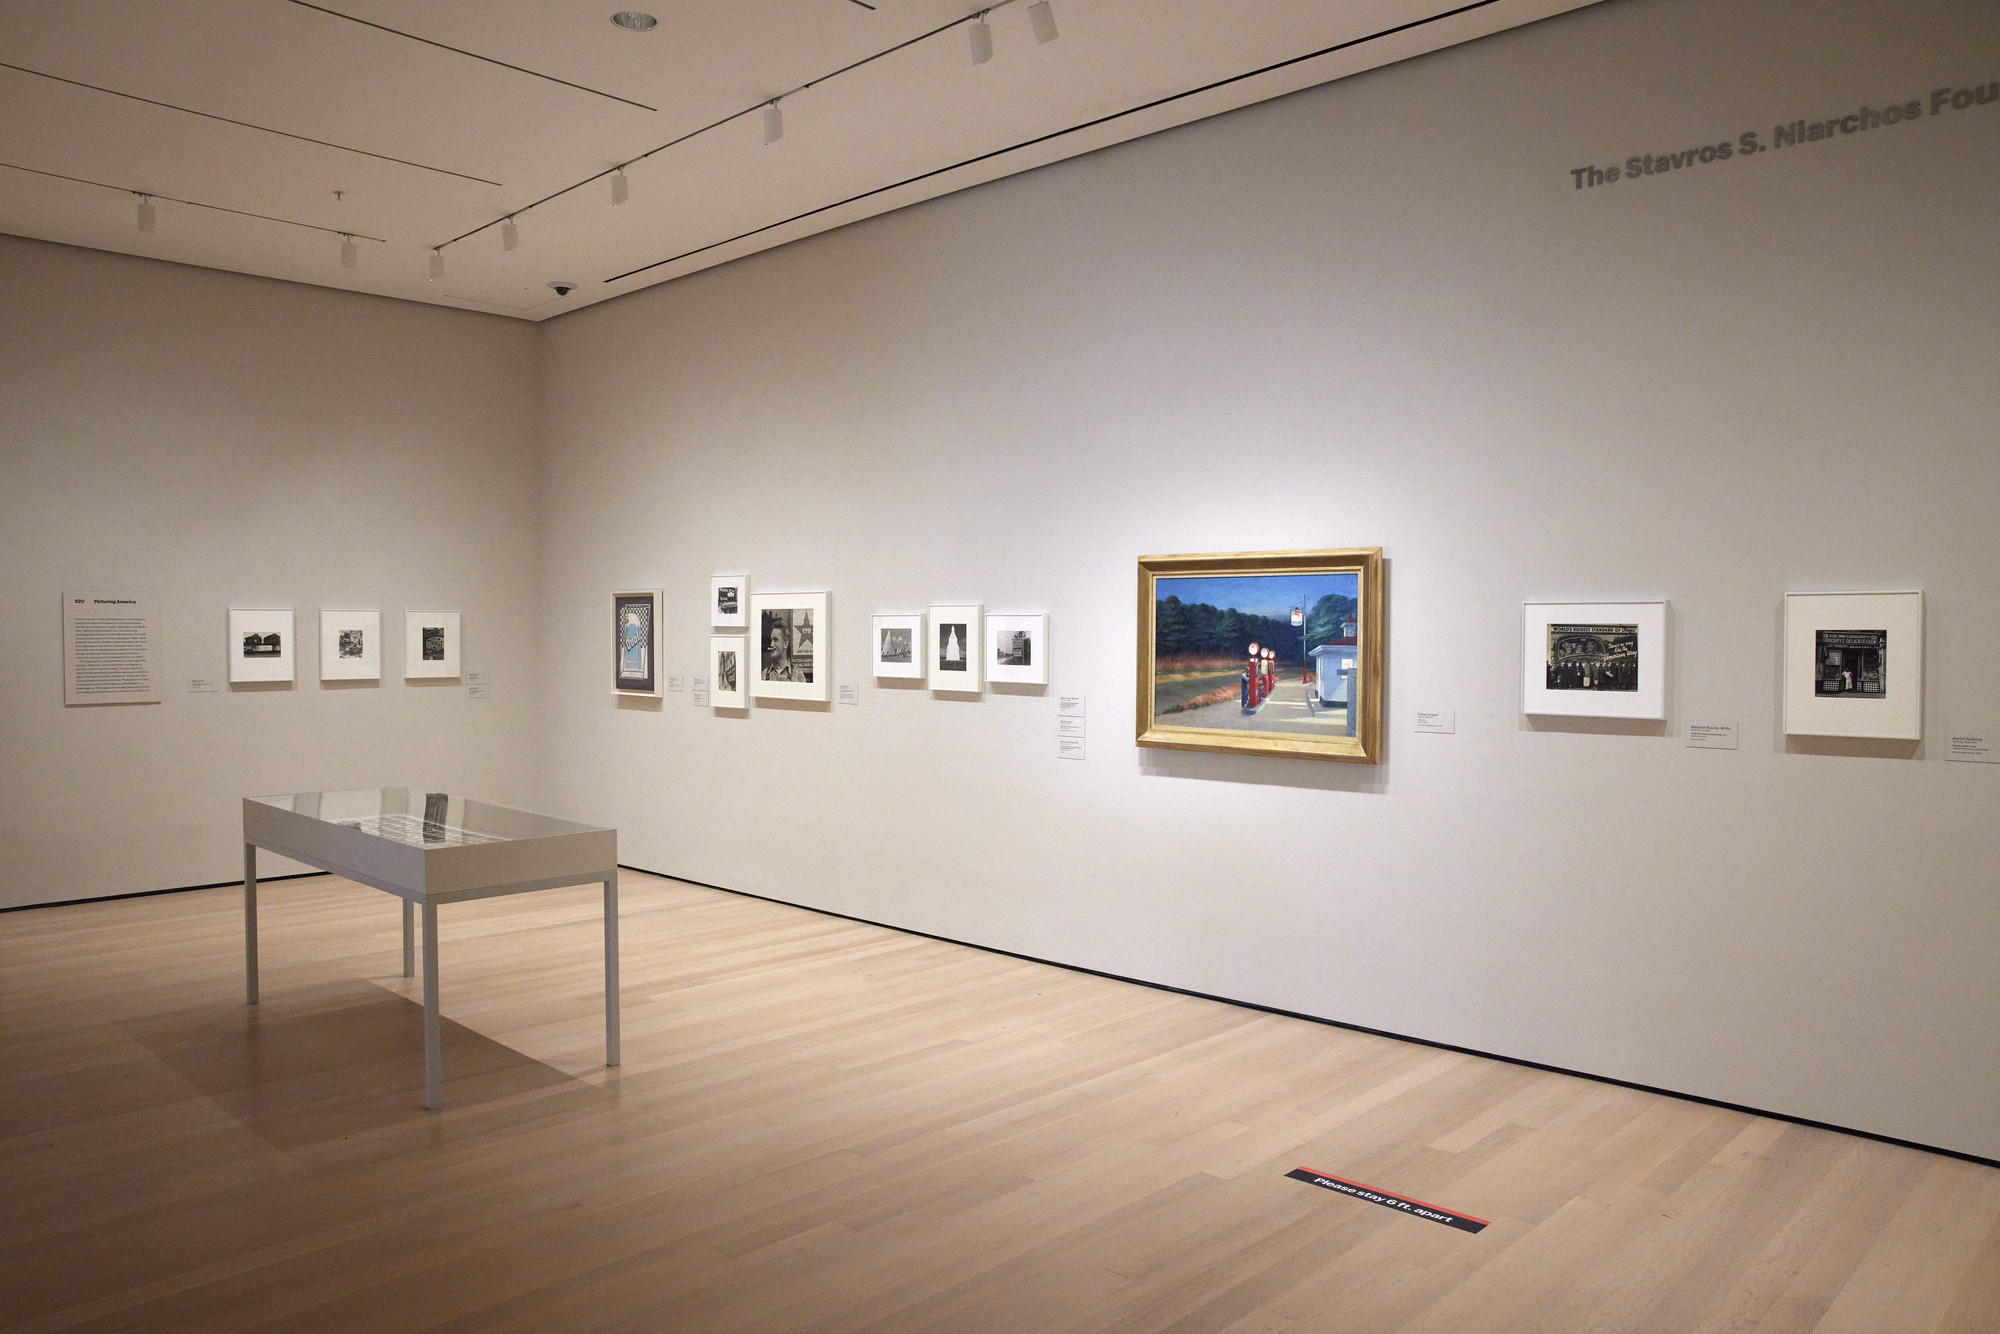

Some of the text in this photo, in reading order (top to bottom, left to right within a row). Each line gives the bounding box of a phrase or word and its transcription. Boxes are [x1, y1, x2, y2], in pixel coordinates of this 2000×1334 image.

[1570, 165, 1620, 190] The
[1624, 142, 1733, 179] Stavros
[1738, 131, 1767, 155] S.
[1774, 101, 1922, 149] Niarchos
[1314, 1177, 1357, 1194] Please
[1356, 1191, 1386, 1202] stay
[1397, 1202, 1411, 1210] ft.
[1413, 1208, 1453, 1222] apart
